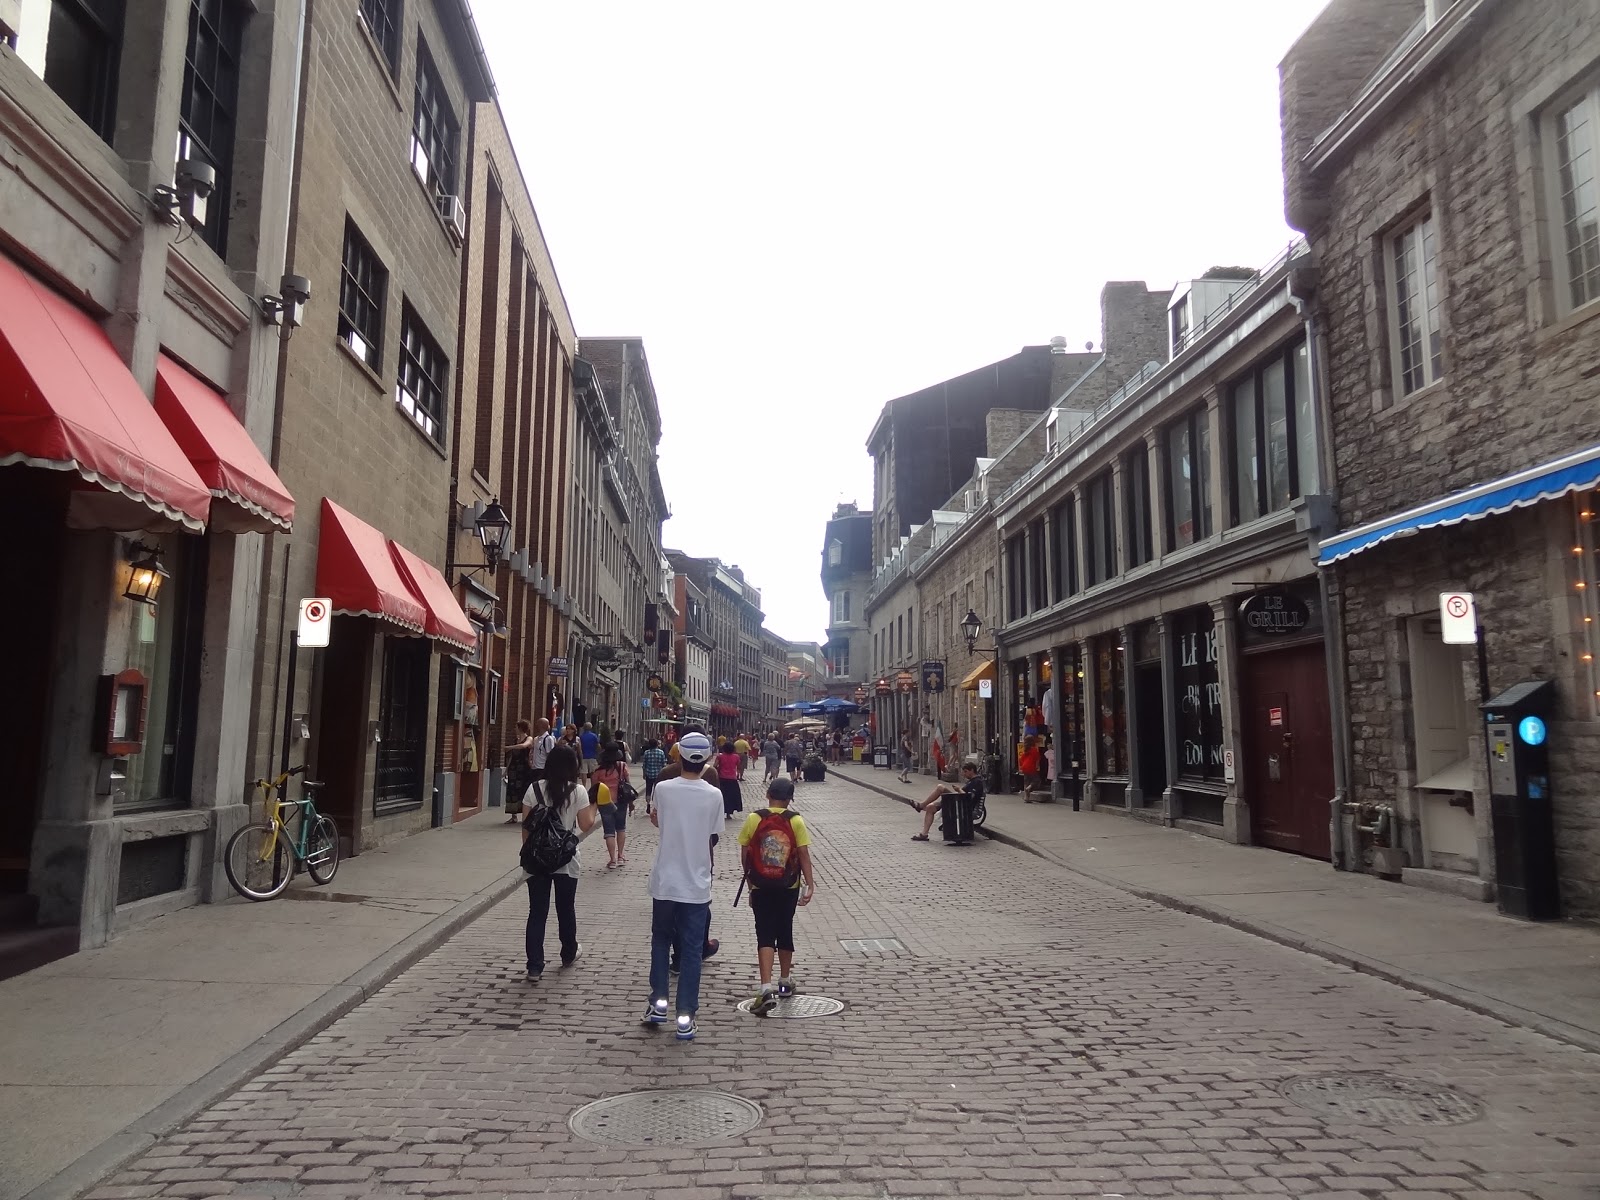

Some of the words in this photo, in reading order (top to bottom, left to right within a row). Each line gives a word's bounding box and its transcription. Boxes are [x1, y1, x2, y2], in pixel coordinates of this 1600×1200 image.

[1264, 596, 1284, 610] LE
[1247, 610, 1305, 628] GRILL
[551, 657, 567, 665] ATM
